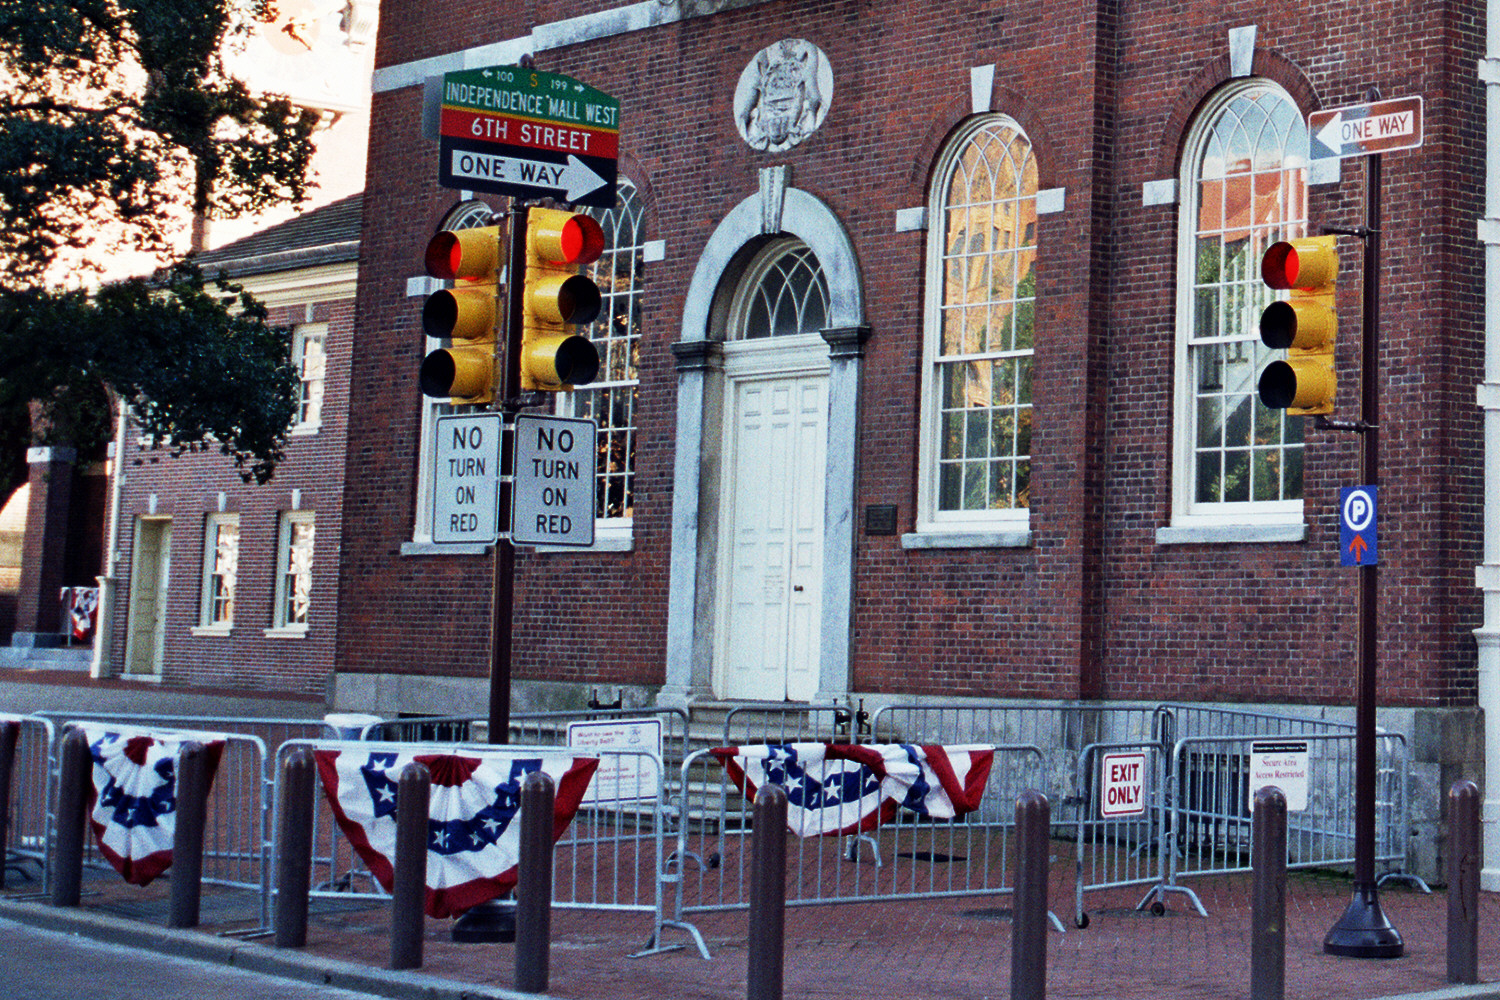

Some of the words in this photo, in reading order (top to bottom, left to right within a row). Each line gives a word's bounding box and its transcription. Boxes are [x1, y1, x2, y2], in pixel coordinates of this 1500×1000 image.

[496, 70, 515, 83] 100
[530, 73, 538, 87] S
[550, 79, 568, 91] 199
[446, 81, 543, 115] INDEPENDENCE
[548, 98, 581, 120] MALL
[585, 103, 618, 126] WEST
[471, 117, 508, 139] 6TH
[520, 123, 592, 151] STREET
[1341, 119, 1373, 141] ONE
[1378, 113, 1409, 136] WAY
[460, 154, 506, 179] ONE
[520, 162, 565, 186] WAY
[453, 425, 483, 450] NO
[537, 426, 574, 453] NO
[448, 457, 486, 477] TURN
[531, 458, 579, 480] TURN
[456, 485, 476, 505] ON
[542, 487, 568, 507] ON
[1352, 500, 1366, 523] P
[450, 513, 479, 532] RED
[536, 514, 572, 535] RED
[1111, 762, 1140, 783] EXIT
[1108, 785, 1141, 806] ONLY
